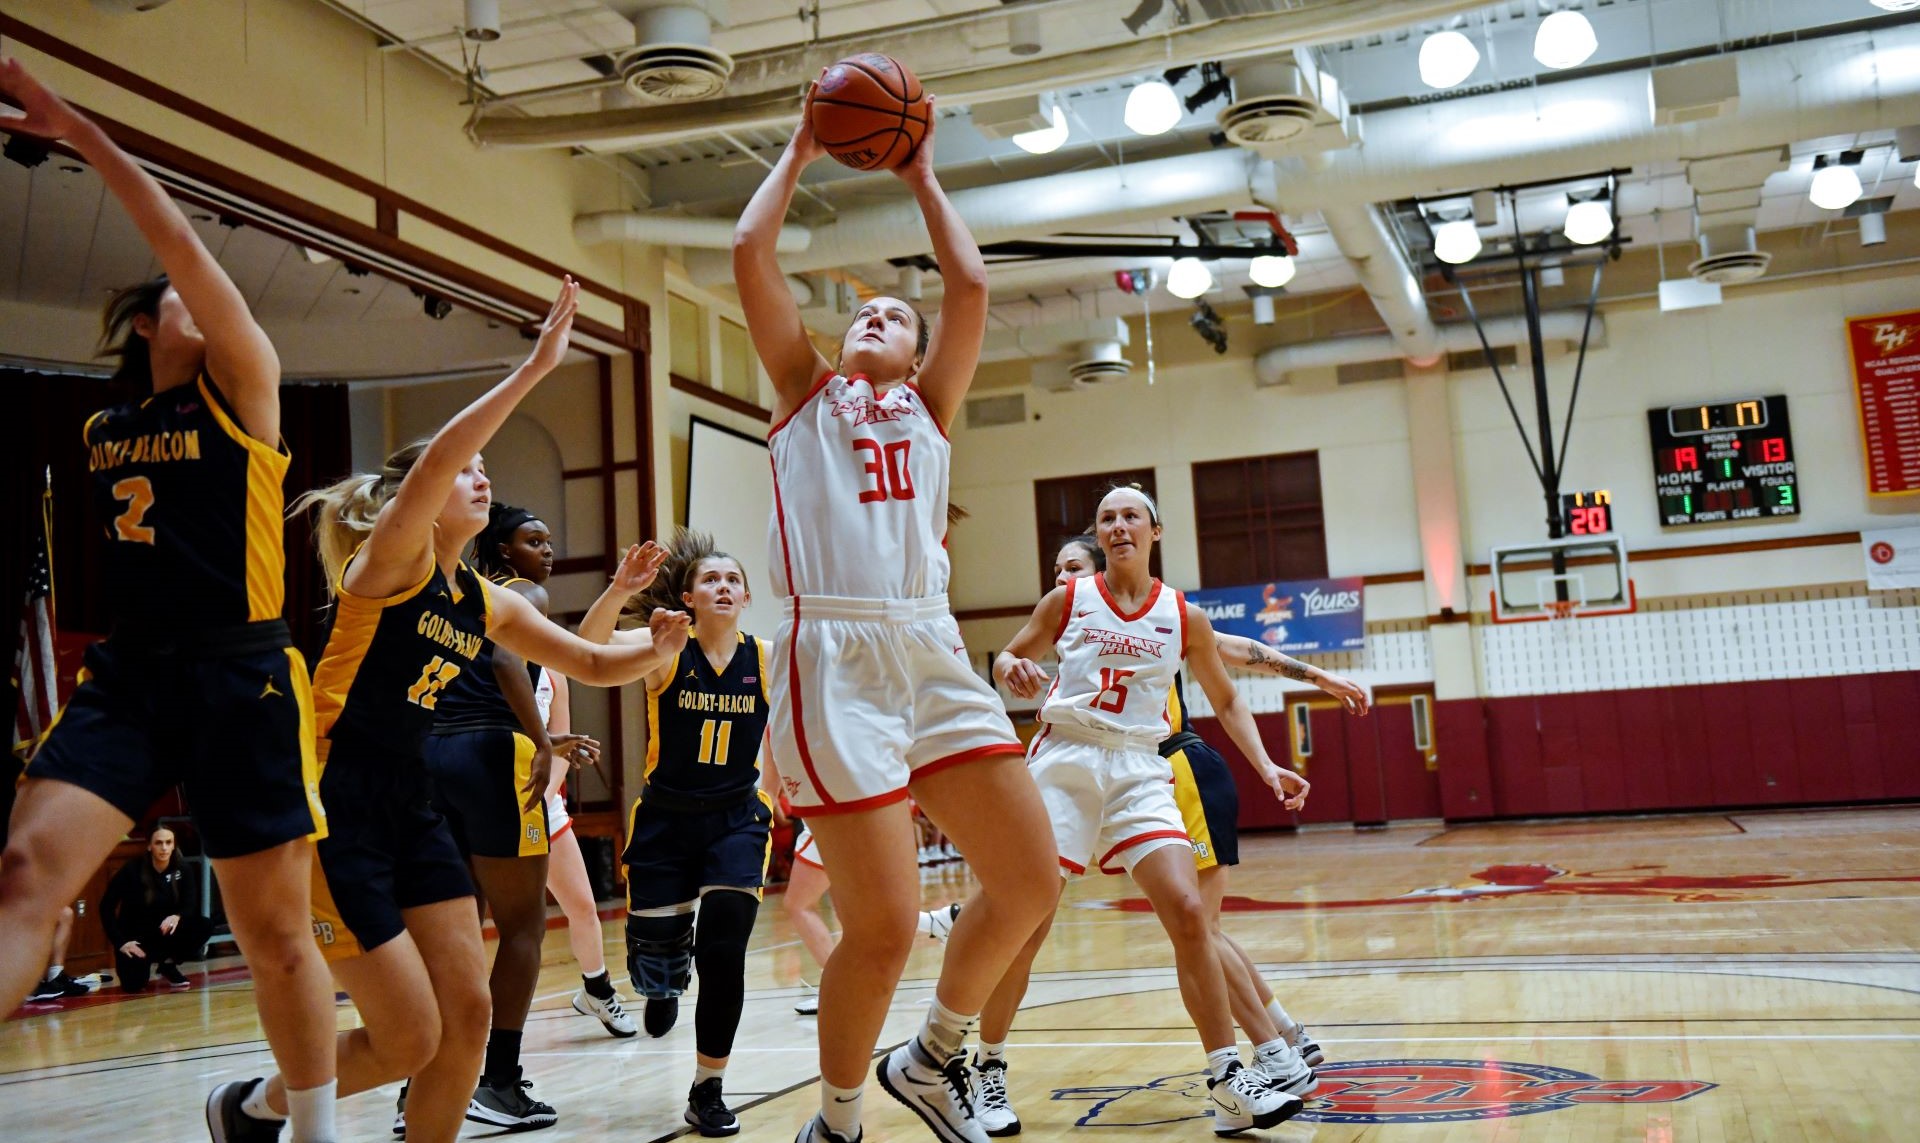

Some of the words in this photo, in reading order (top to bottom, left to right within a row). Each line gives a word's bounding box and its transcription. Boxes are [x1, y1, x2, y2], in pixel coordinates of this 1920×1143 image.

[1674, 447, 1698, 472] 19
[1762, 438, 1786, 463] 13
[852, 438, 915, 504] 30
[1657, 470, 1703, 486] HOME
[1724, 458, 1732, 478] 1
[1741, 462, 1795, 478] VISITOR
[1659, 485, 1692, 496] FOULS
[1707, 480, 1745, 492] PLAYER
[1760, 475, 1795, 486] FOULS
[1683, 494, 1692, 514] 1
[1777, 485, 1793, 505] 3
[1570, 507, 1607, 535] 20
[1667, 514, 1690, 525] WON
[1694, 510, 1727, 522] POINTS
[1732, 507, 1760, 518] GAME
[1771, 506, 1795, 516] WON
[1082, 628, 1166, 658] CHESTNUT
[1089, 667, 1136, 714] 15
[678, 689, 756, 714] GOLDEY-BEACON
[697, 719, 732, 765] 11
[1296, 1112, 1395, 1121] ATLAN
